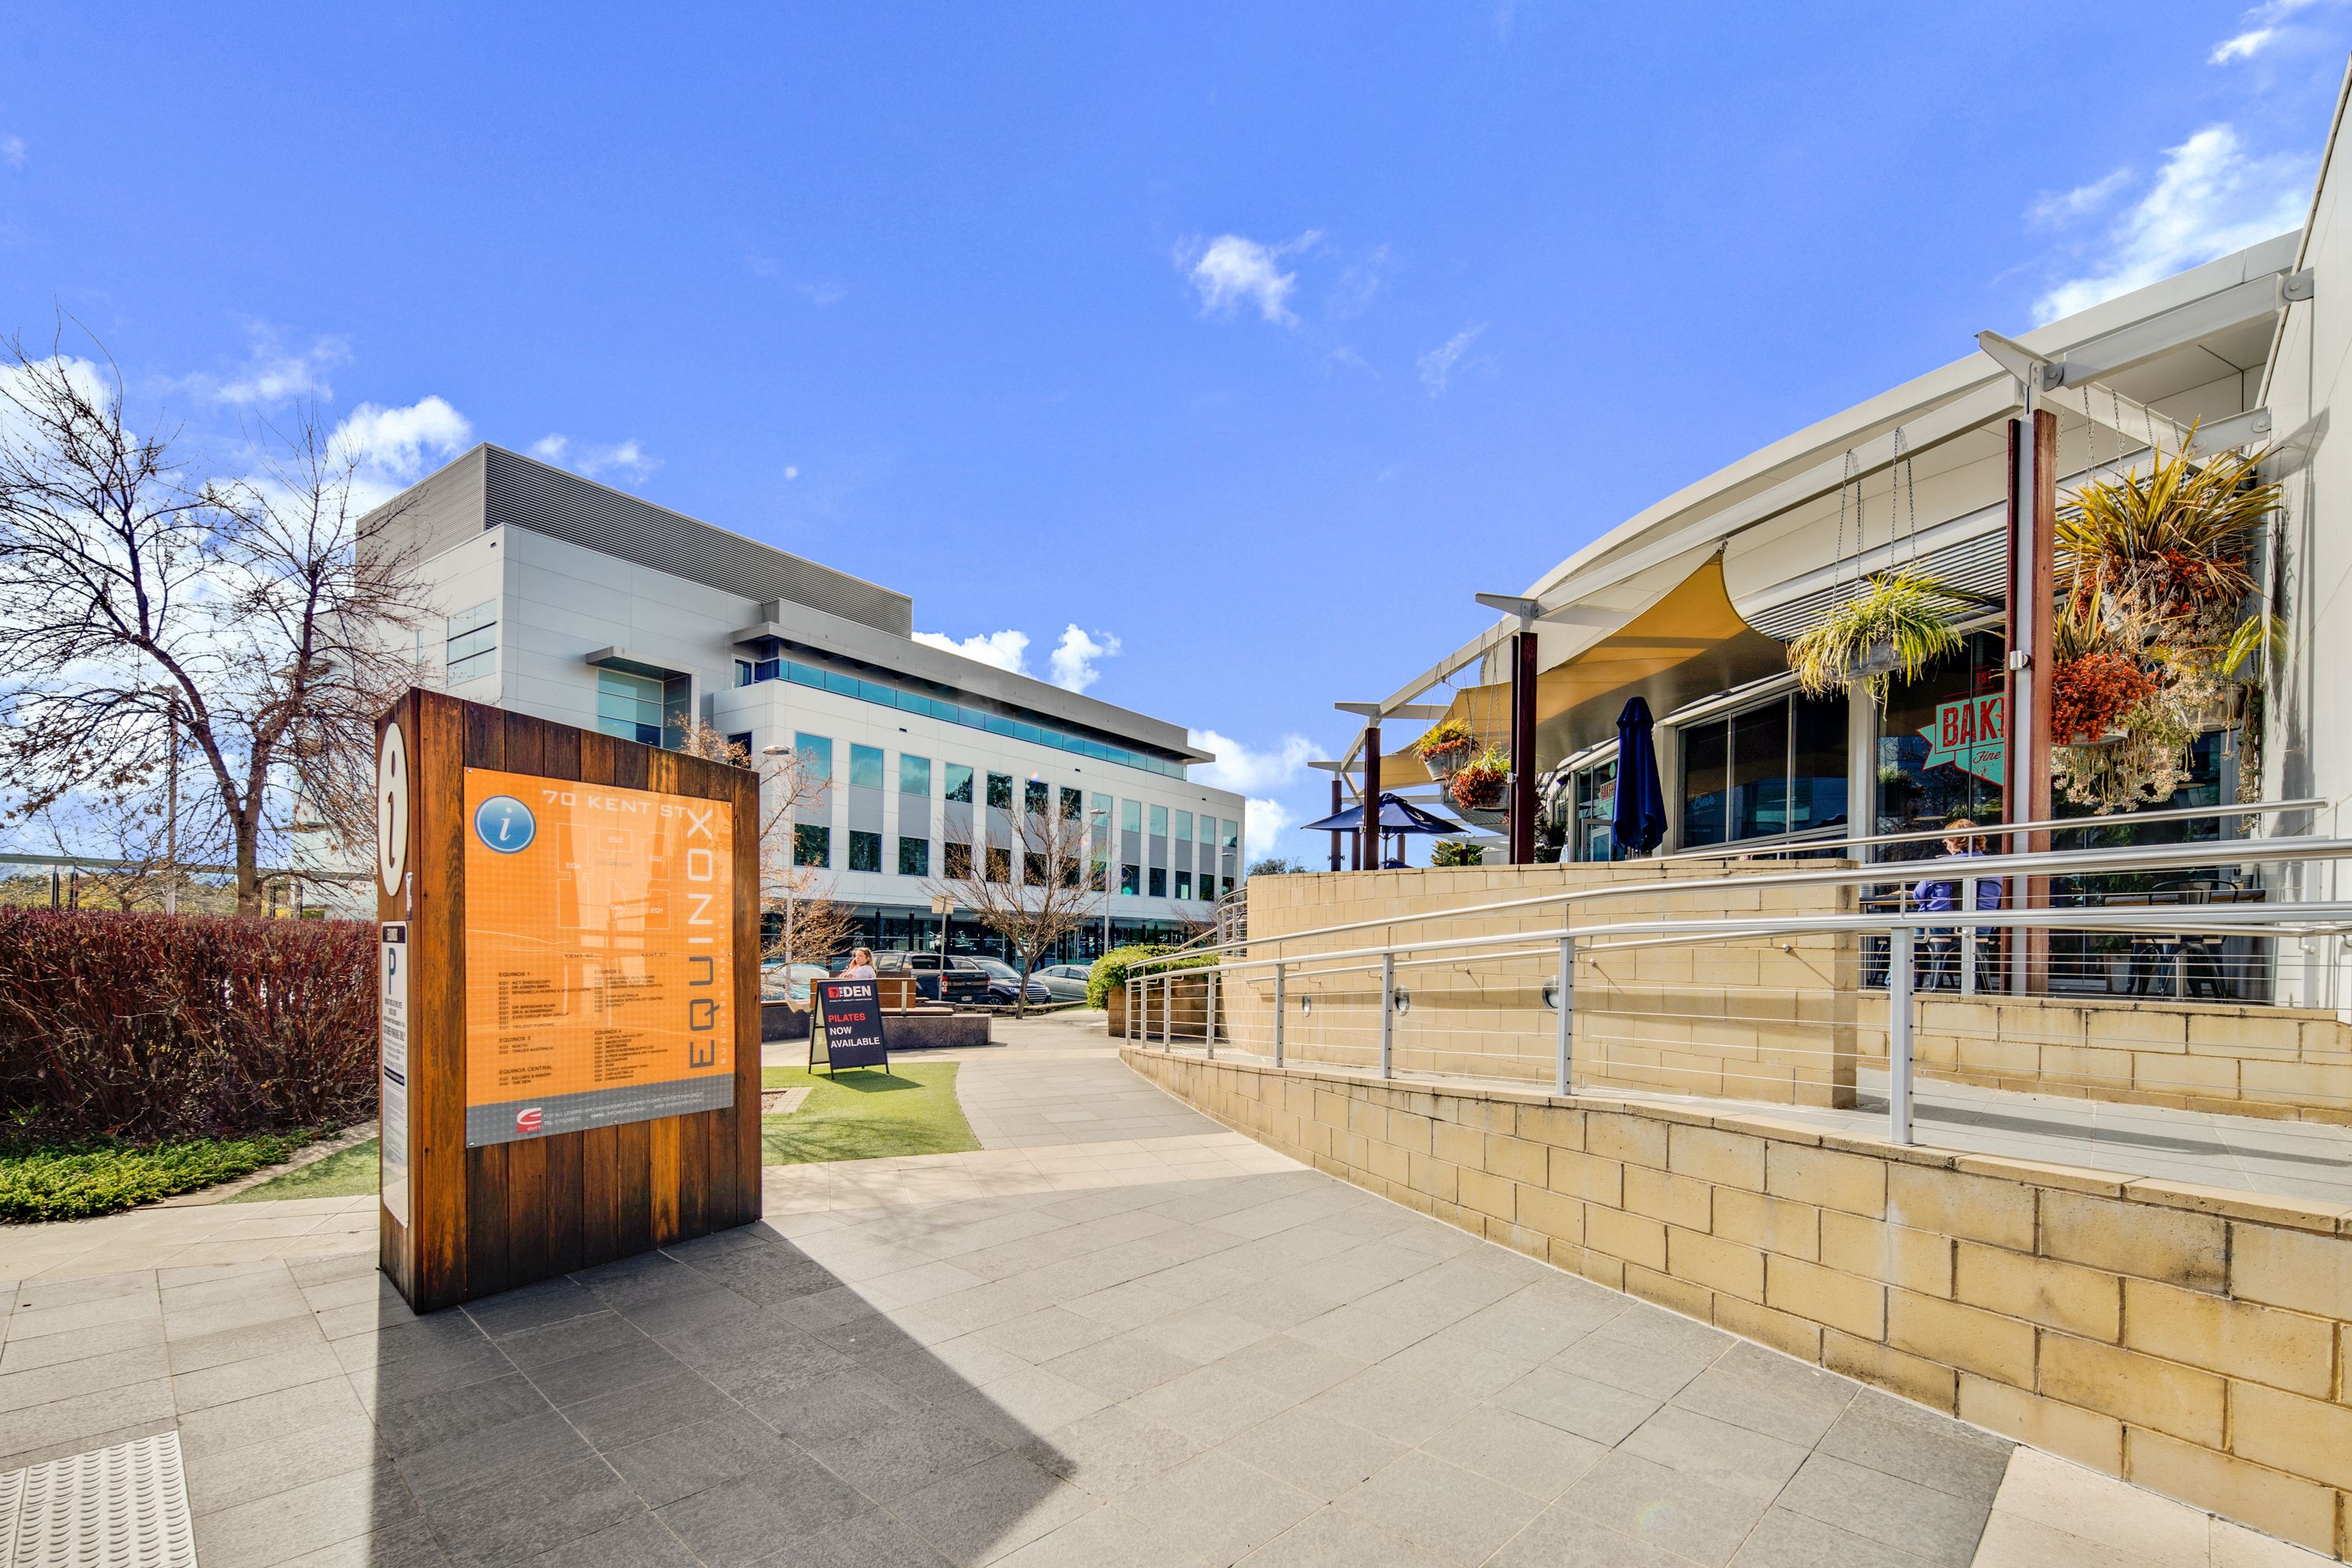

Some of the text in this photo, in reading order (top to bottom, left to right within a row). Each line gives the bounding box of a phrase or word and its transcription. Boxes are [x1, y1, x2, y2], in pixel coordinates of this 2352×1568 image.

[1973, 751, 2001, 764] Fine
[543, 789, 687, 819] 70 KENT ST
[687, 808, 720, 1069] EQUINOX
[388, 947, 396, 995] P
[843, 985, 872, 997] DEN
[828, 1013, 866, 1022] PILATES
[829, 1026, 852, 1035] NOW
[831, 1036, 880, 1048] AVAILABLE
